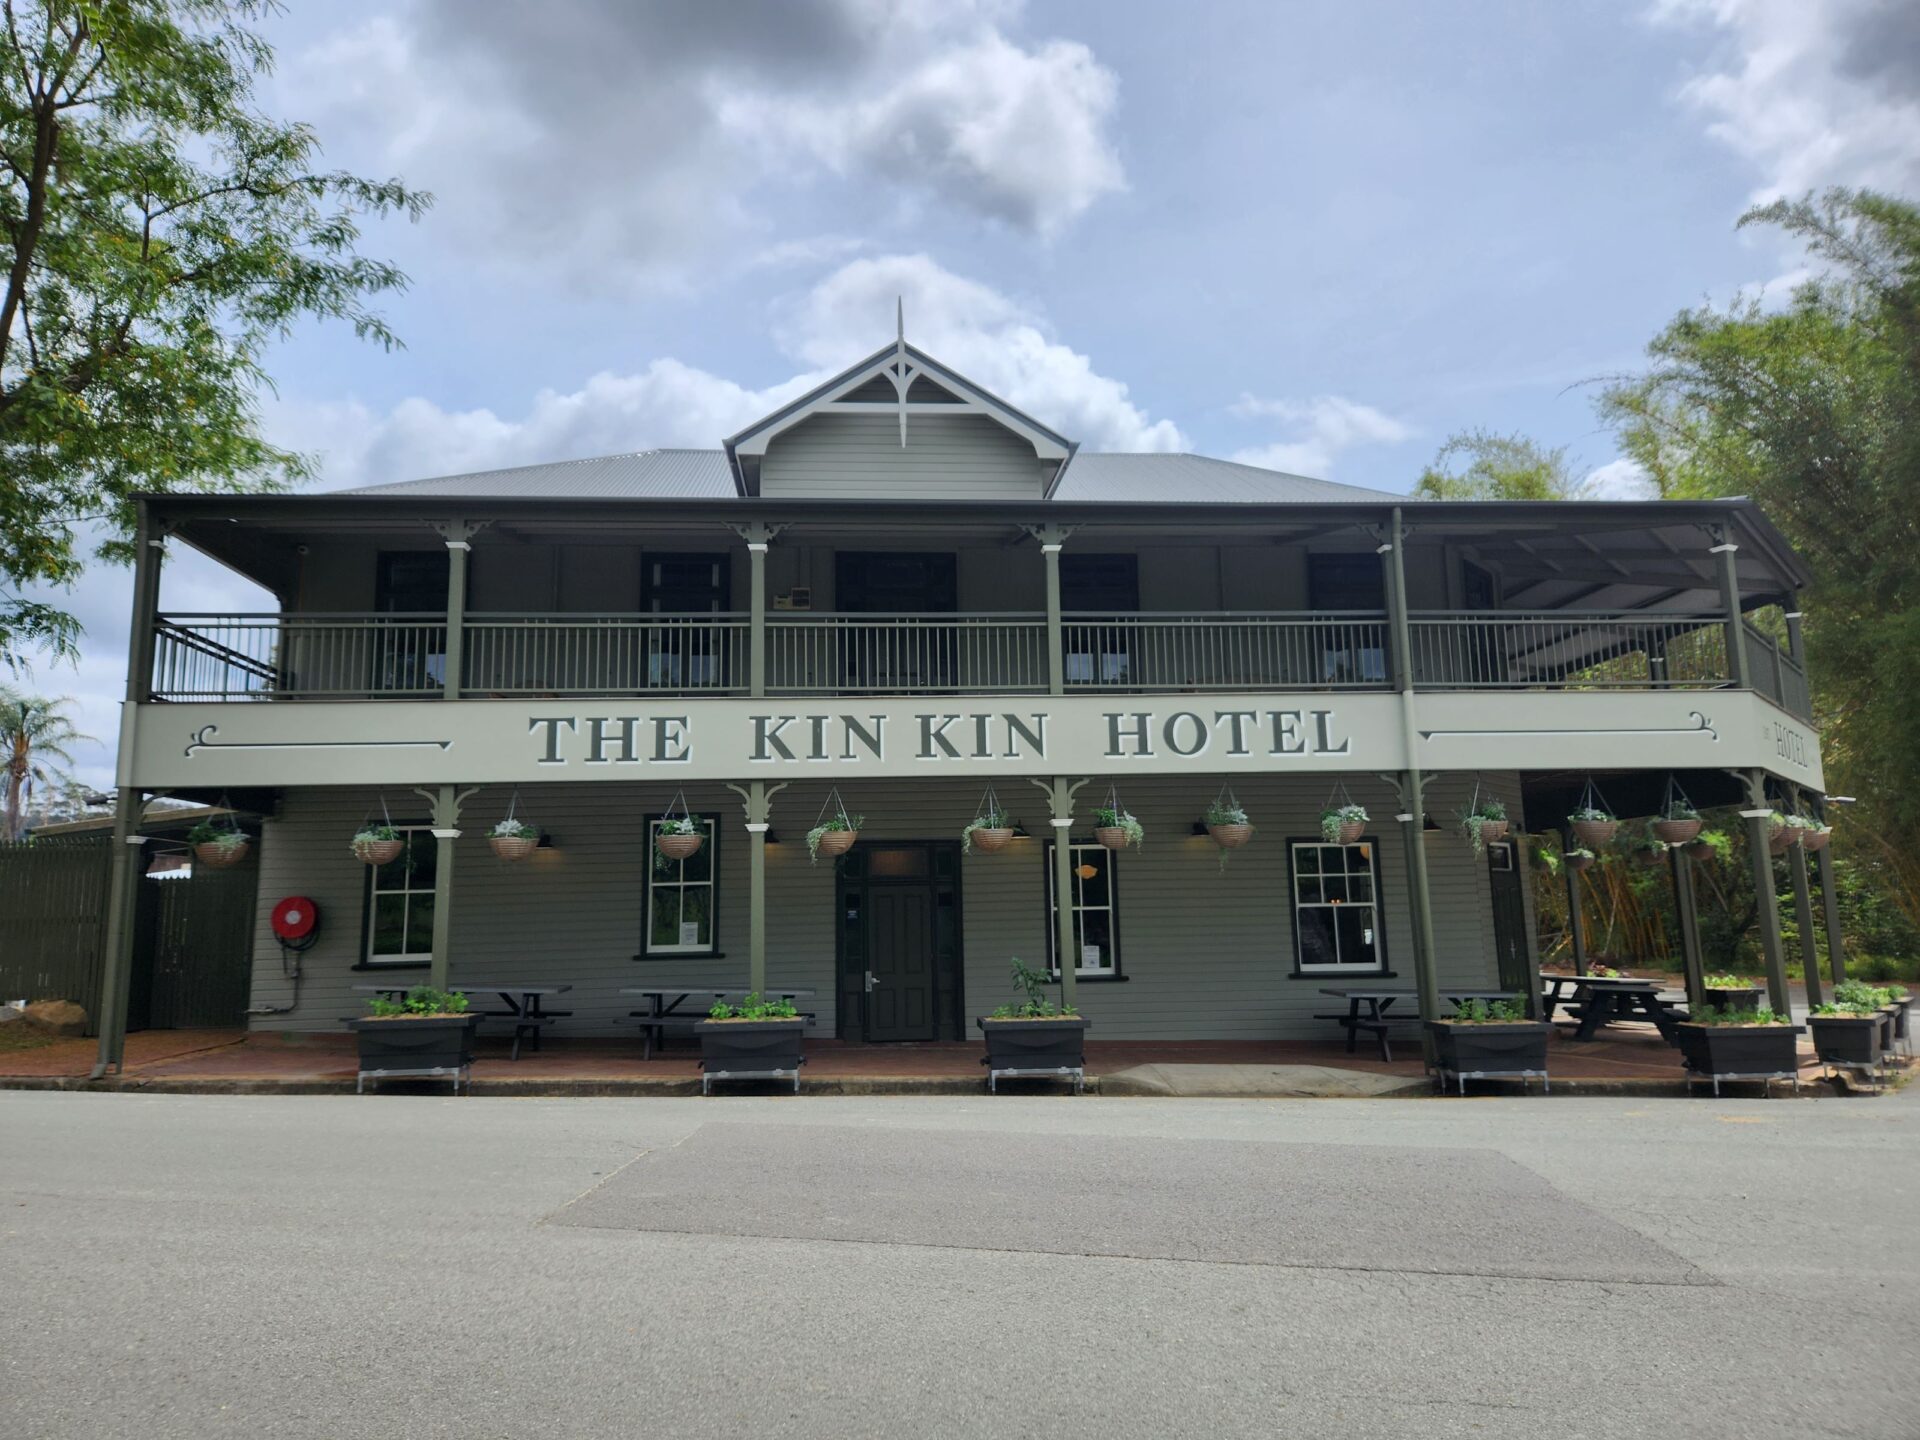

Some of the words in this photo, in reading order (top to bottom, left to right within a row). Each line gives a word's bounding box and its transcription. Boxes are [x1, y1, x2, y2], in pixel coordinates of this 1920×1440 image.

[528, 715, 692, 764] THE
[748, 714, 889, 762] KIN
[914, 713, 1050, 760] KIN
[1101, 709, 1350, 758] HOTEL
[1773, 721, 1808, 768] HOTEL
